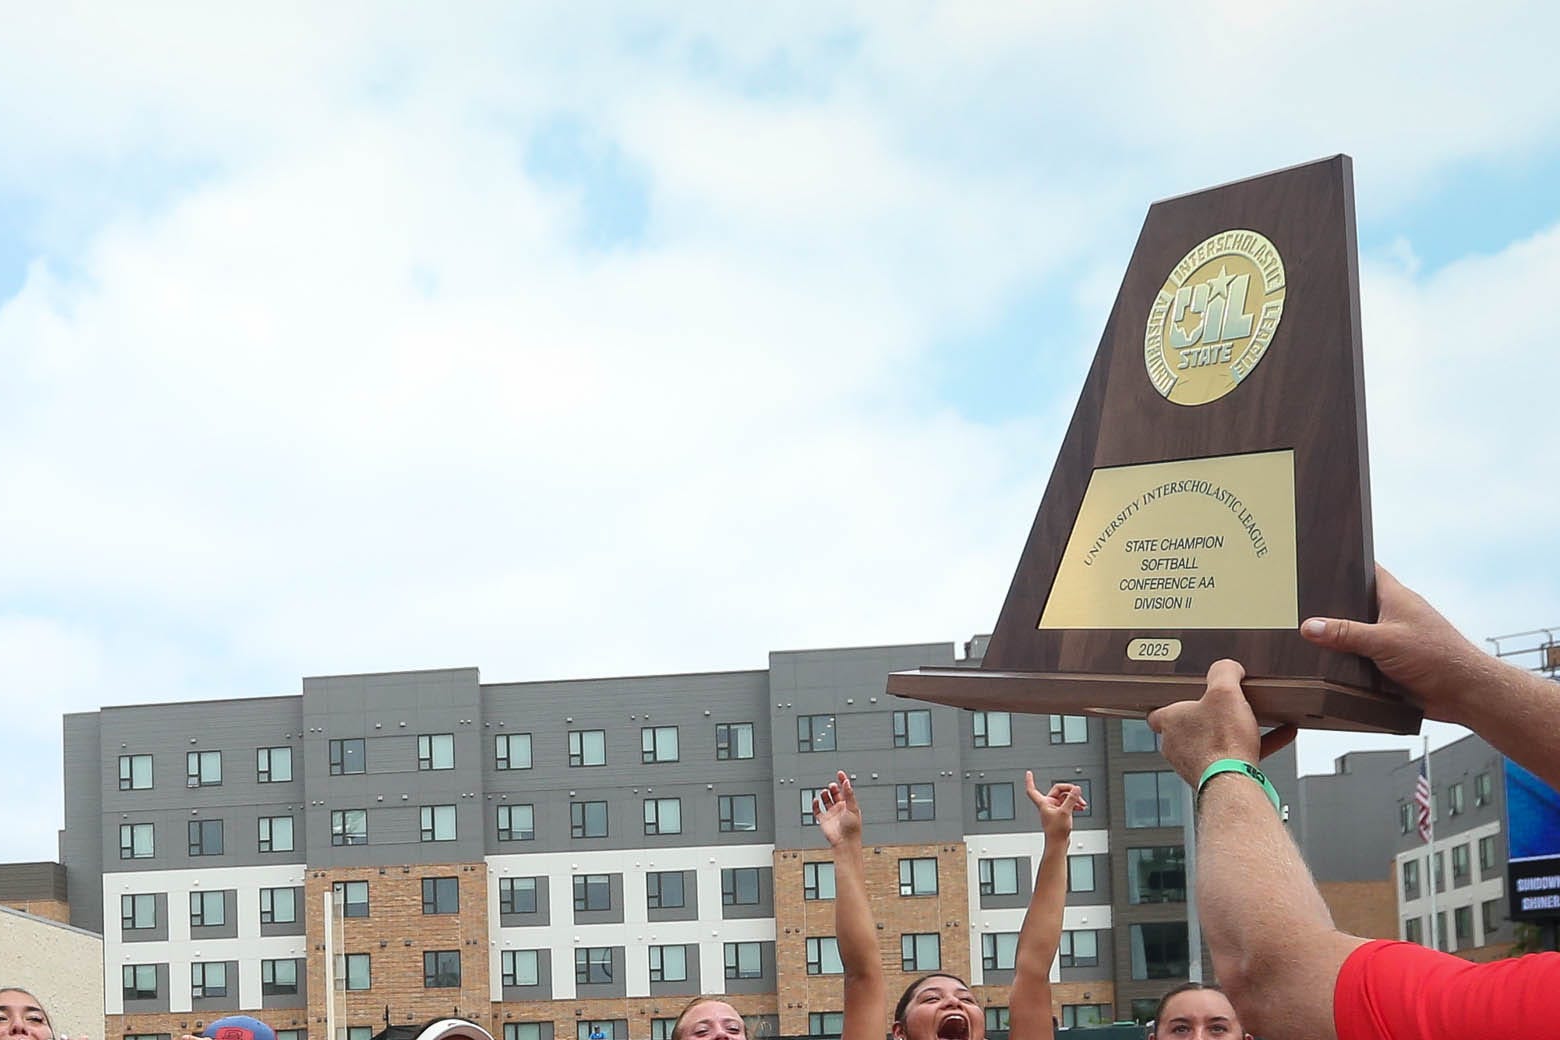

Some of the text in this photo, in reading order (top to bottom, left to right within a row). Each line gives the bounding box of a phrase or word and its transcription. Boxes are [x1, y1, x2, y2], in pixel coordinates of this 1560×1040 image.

[1171, 231, 1285, 290] INTERSCHOLASTIC
[1178, 342, 1234, 370] STATE
[1084, 479, 1269, 567] UNIVERSITY INTERSCHOLASTIC LEAGUE
[1125, 535, 1225, 553] STATE CHAMPION
[1140, 557, 1199, 571] SOFTBALL
[1119, 576, 1216, 591] CONFERENCE AA
[1134, 597, 1193, 610] DIVISION II
[1138, 643, 1170, 657] 2025
